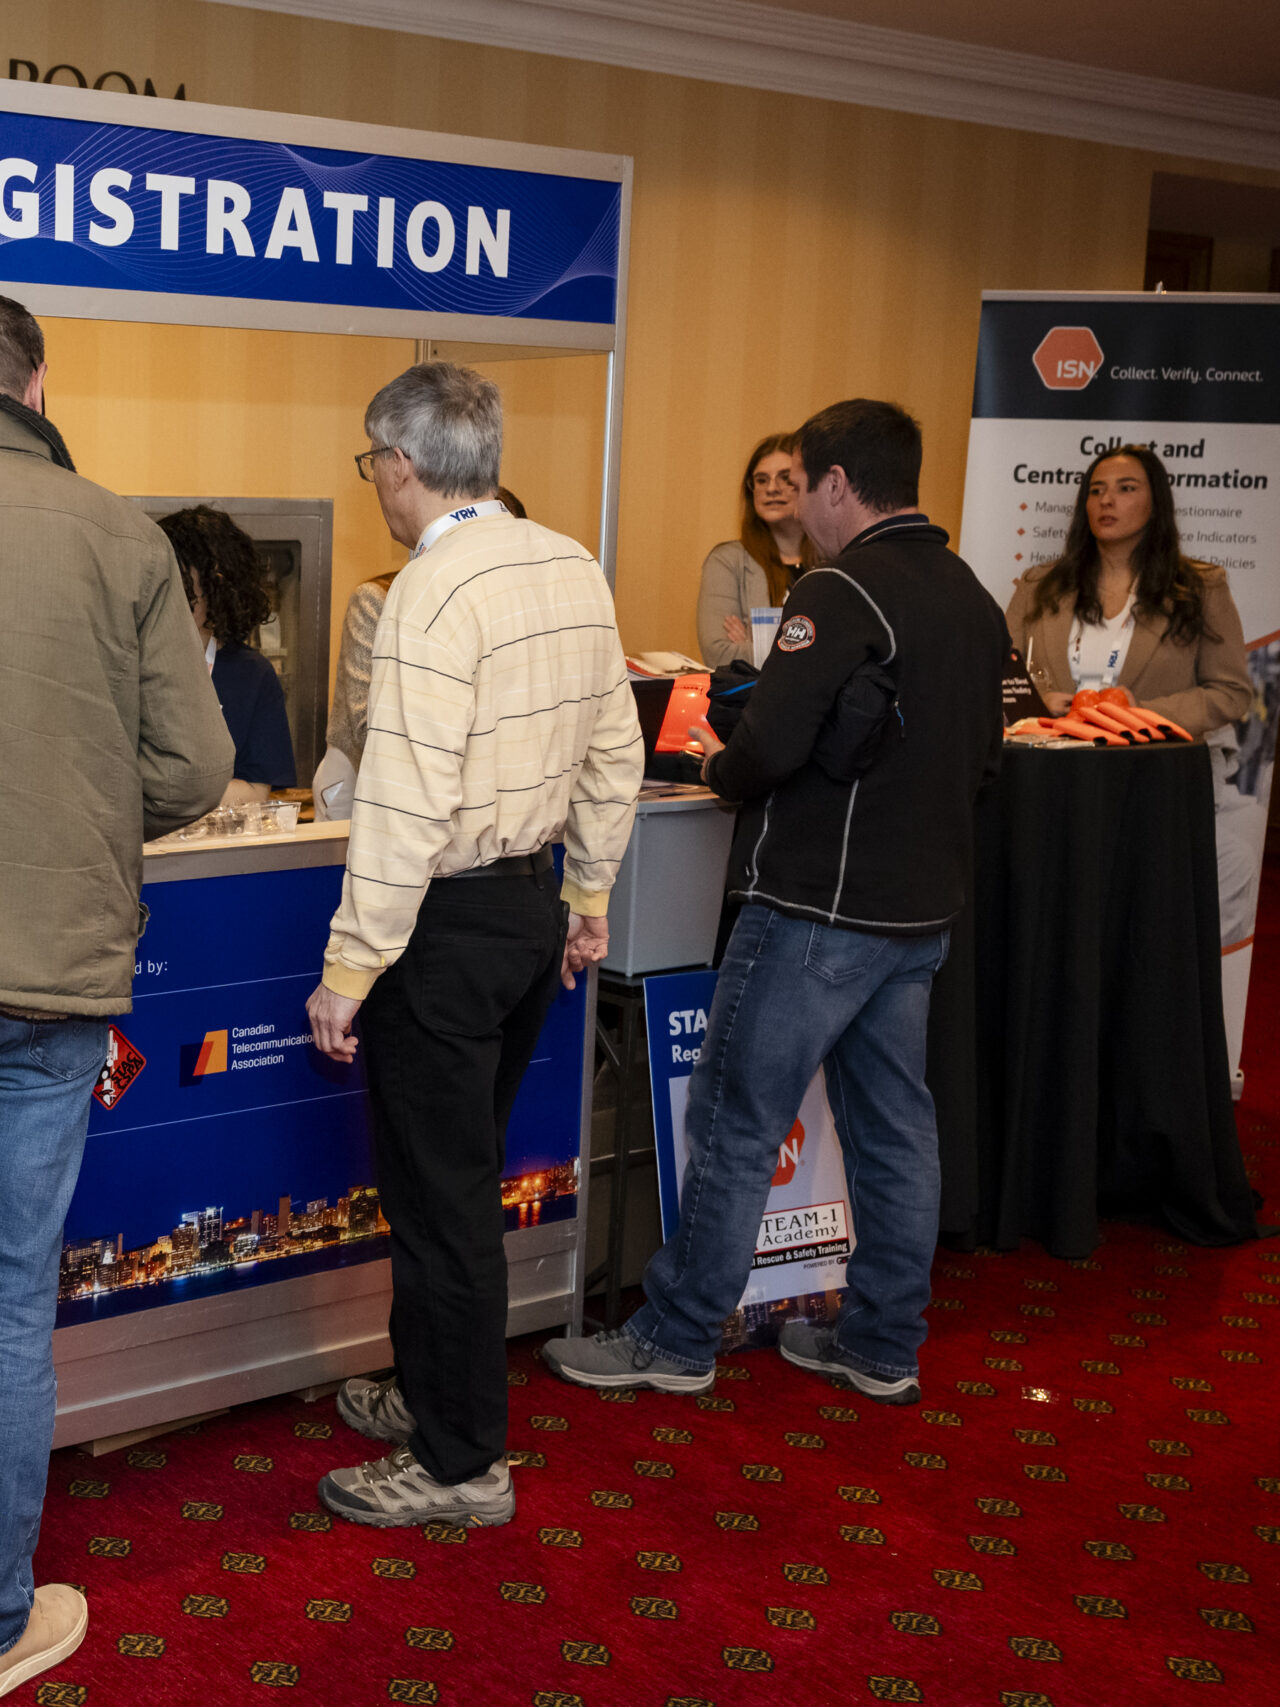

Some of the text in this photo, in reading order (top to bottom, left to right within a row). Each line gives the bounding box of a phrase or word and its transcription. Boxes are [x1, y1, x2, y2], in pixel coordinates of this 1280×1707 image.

[1056, 360, 1263, 384] ISN Collect. Verify. Connect.
[1080, 436, 1206, 458] Collt and
[450, 507, 477, 521] YRH
[1174, 505, 1243, 518] estionnaire
[1197, 531, 1257, 544] Indicators
[786, 626, 807, 639] HH
[147, 959, 168, 976] by:
[231, 1023, 275, 1038] Canadian
[669, 1008, 708, 1036] STA
[231, 1033, 314, 1054] Telecommunicatio
[231, 1054, 284, 1071] Association
[763, 1225, 839, 1247] Academy
[757, 1255, 784, 1266] Rescue
[785, 1251, 792, 1260] &
[793, 1249, 816, 1260] Safety
[818, 1242, 848, 1254] Training
